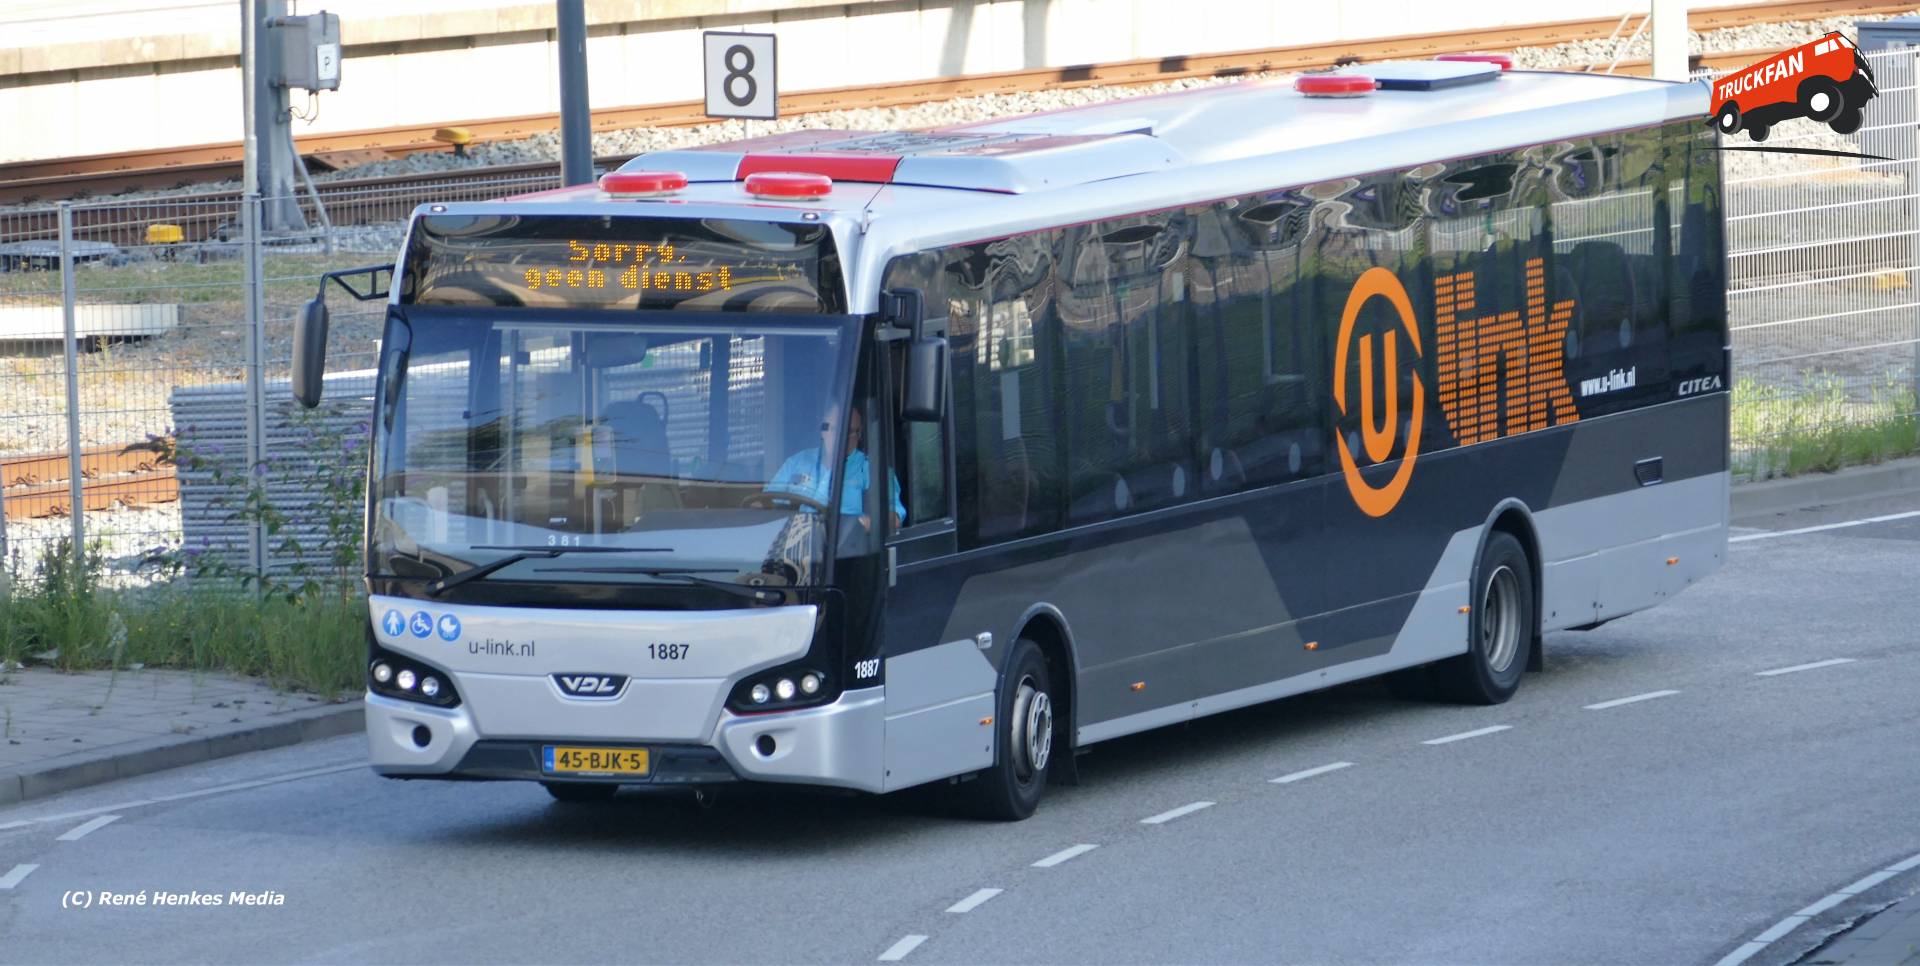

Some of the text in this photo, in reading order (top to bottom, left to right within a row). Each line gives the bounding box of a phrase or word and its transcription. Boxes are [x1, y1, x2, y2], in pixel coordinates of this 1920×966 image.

[723, 44, 757, 107] 8
[569, 240, 686, 263] Sorry,
[525, 264, 732, 291] geen dienst
[1581, 365, 1636, 397] www.u-link.nl
[1678, 375, 1722, 396] CITEA
[468, 639, 536, 657] u-link.nl
[648, 643, 690, 660] 1887
[855, 658, 880, 679] 1887
[561, 676, 617, 693] VDL
[559, 751, 641, 770] 45-BJK-5
